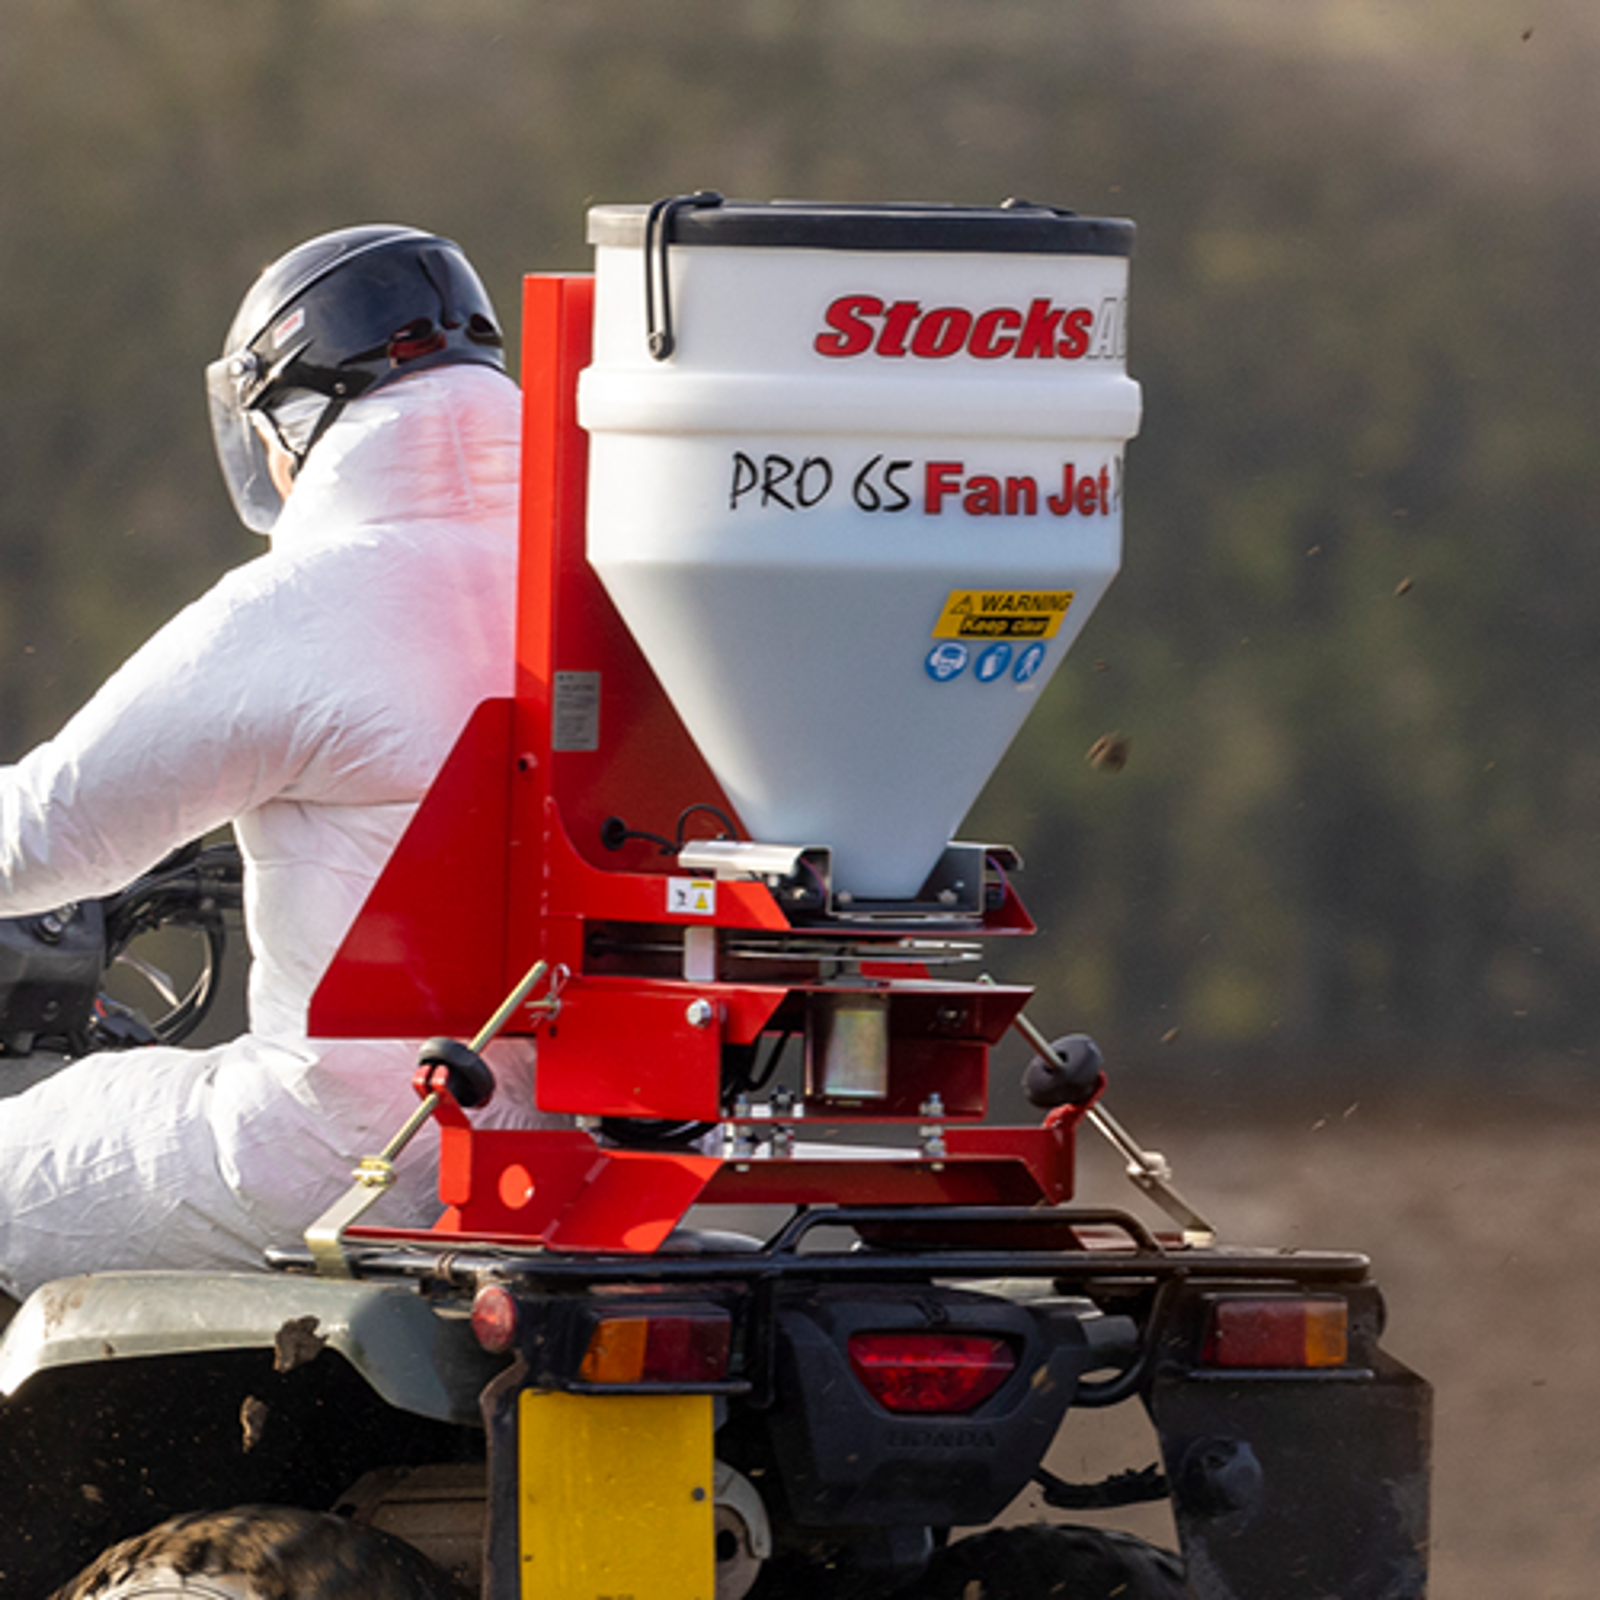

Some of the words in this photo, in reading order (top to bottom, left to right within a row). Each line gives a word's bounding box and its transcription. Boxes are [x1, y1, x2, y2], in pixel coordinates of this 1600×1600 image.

[730, 451, 834, 510] PRO
[852, 454, 913, 512] 65
[923, 461, 1038, 516] Fan
[1046, 462, 1111, 516] Jet
[981, 592, 1074, 612] WARNING
[885, 1430, 997, 1447] HONDA
